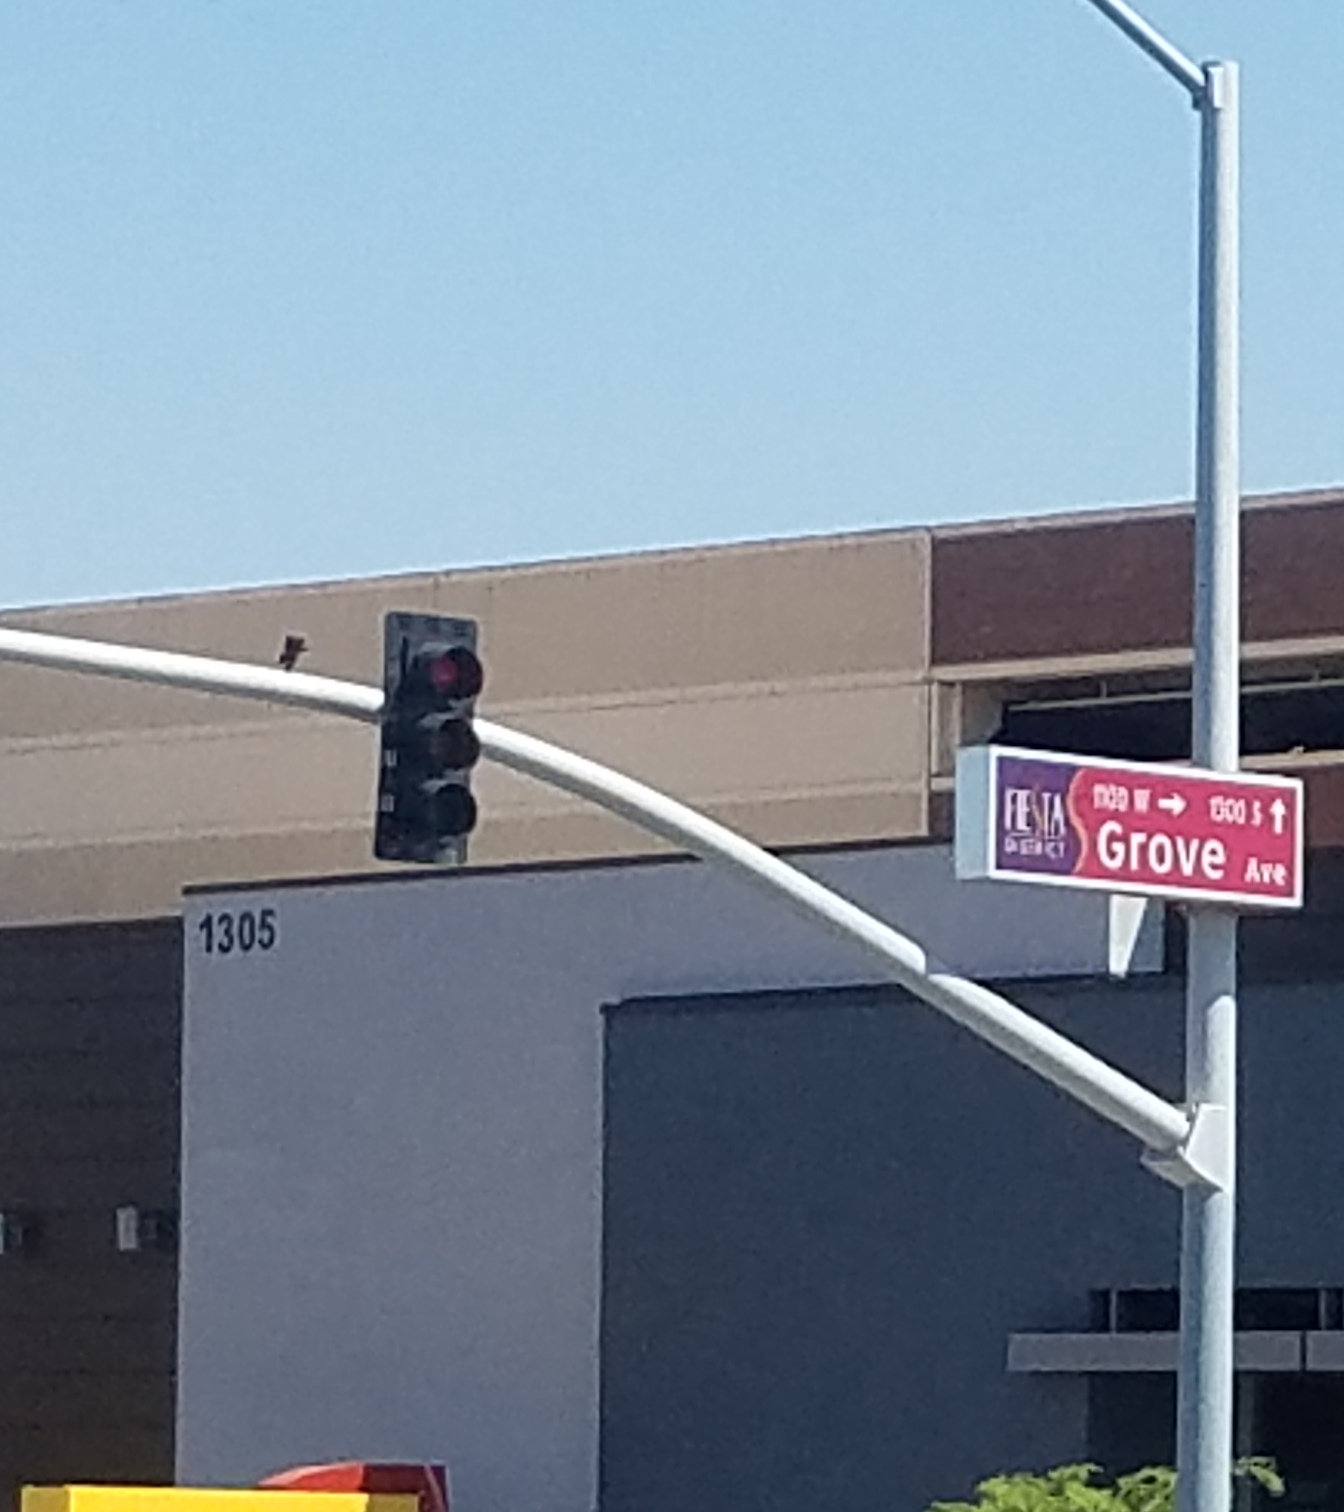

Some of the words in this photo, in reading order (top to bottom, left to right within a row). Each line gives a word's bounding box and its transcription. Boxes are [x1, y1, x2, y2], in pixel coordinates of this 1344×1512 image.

[1004, 785, 1066, 838] FIESTA
[1133, 788, 1151, 813] W
[1252, 800, 1263, 827] S
[1097, 820, 1227, 878] Grove
[1244, 857, 1288, 885] Ave
[199, 909, 276, 954] 1305
